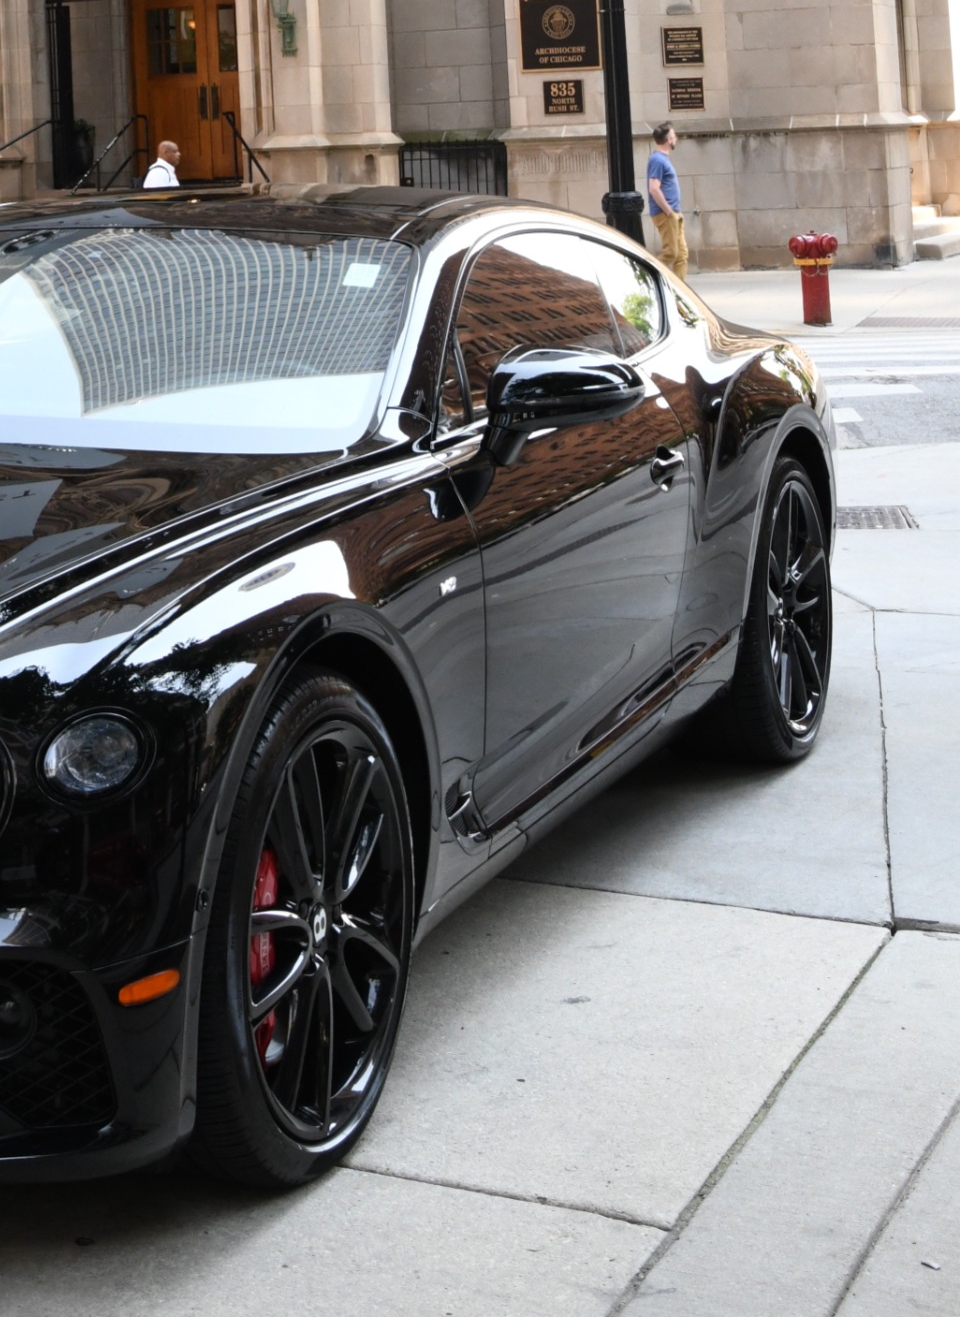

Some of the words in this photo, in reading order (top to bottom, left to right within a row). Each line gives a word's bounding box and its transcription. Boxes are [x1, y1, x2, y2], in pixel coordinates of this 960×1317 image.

[534, 46, 586, 55] ARCHDIOCESE
[549, 55, 583, 63] CHICAGO
[550, 82, 576, 97] 835
[551, 97, 575, 105] NORTH
[548, 105, 567, 113] RUSH
